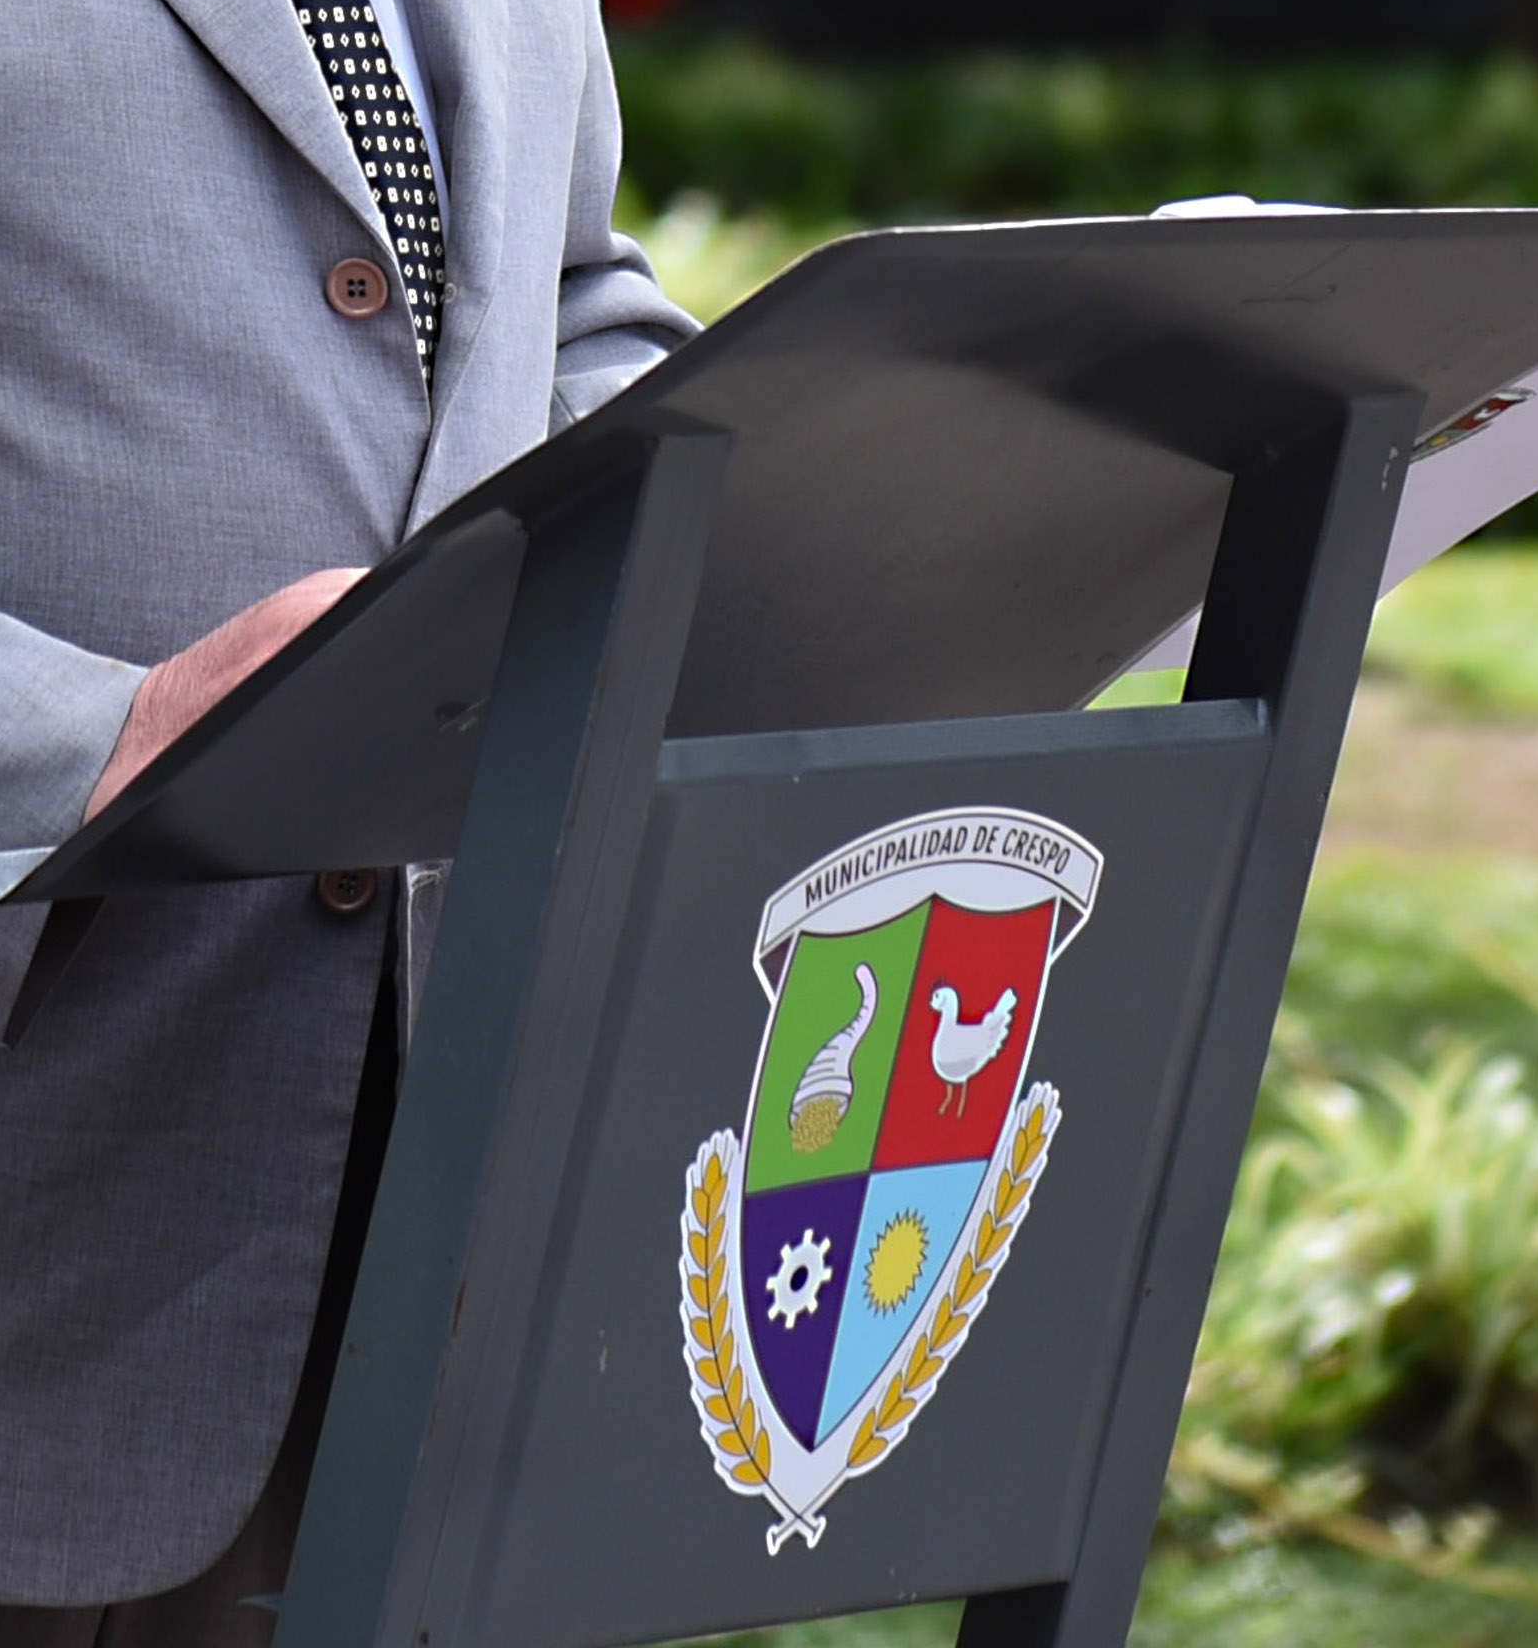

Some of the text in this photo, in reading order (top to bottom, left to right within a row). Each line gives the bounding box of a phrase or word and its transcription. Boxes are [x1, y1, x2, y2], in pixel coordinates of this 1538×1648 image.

[804, 824, 1071, 908] MUNICIPALIDAD DE CRESPO
